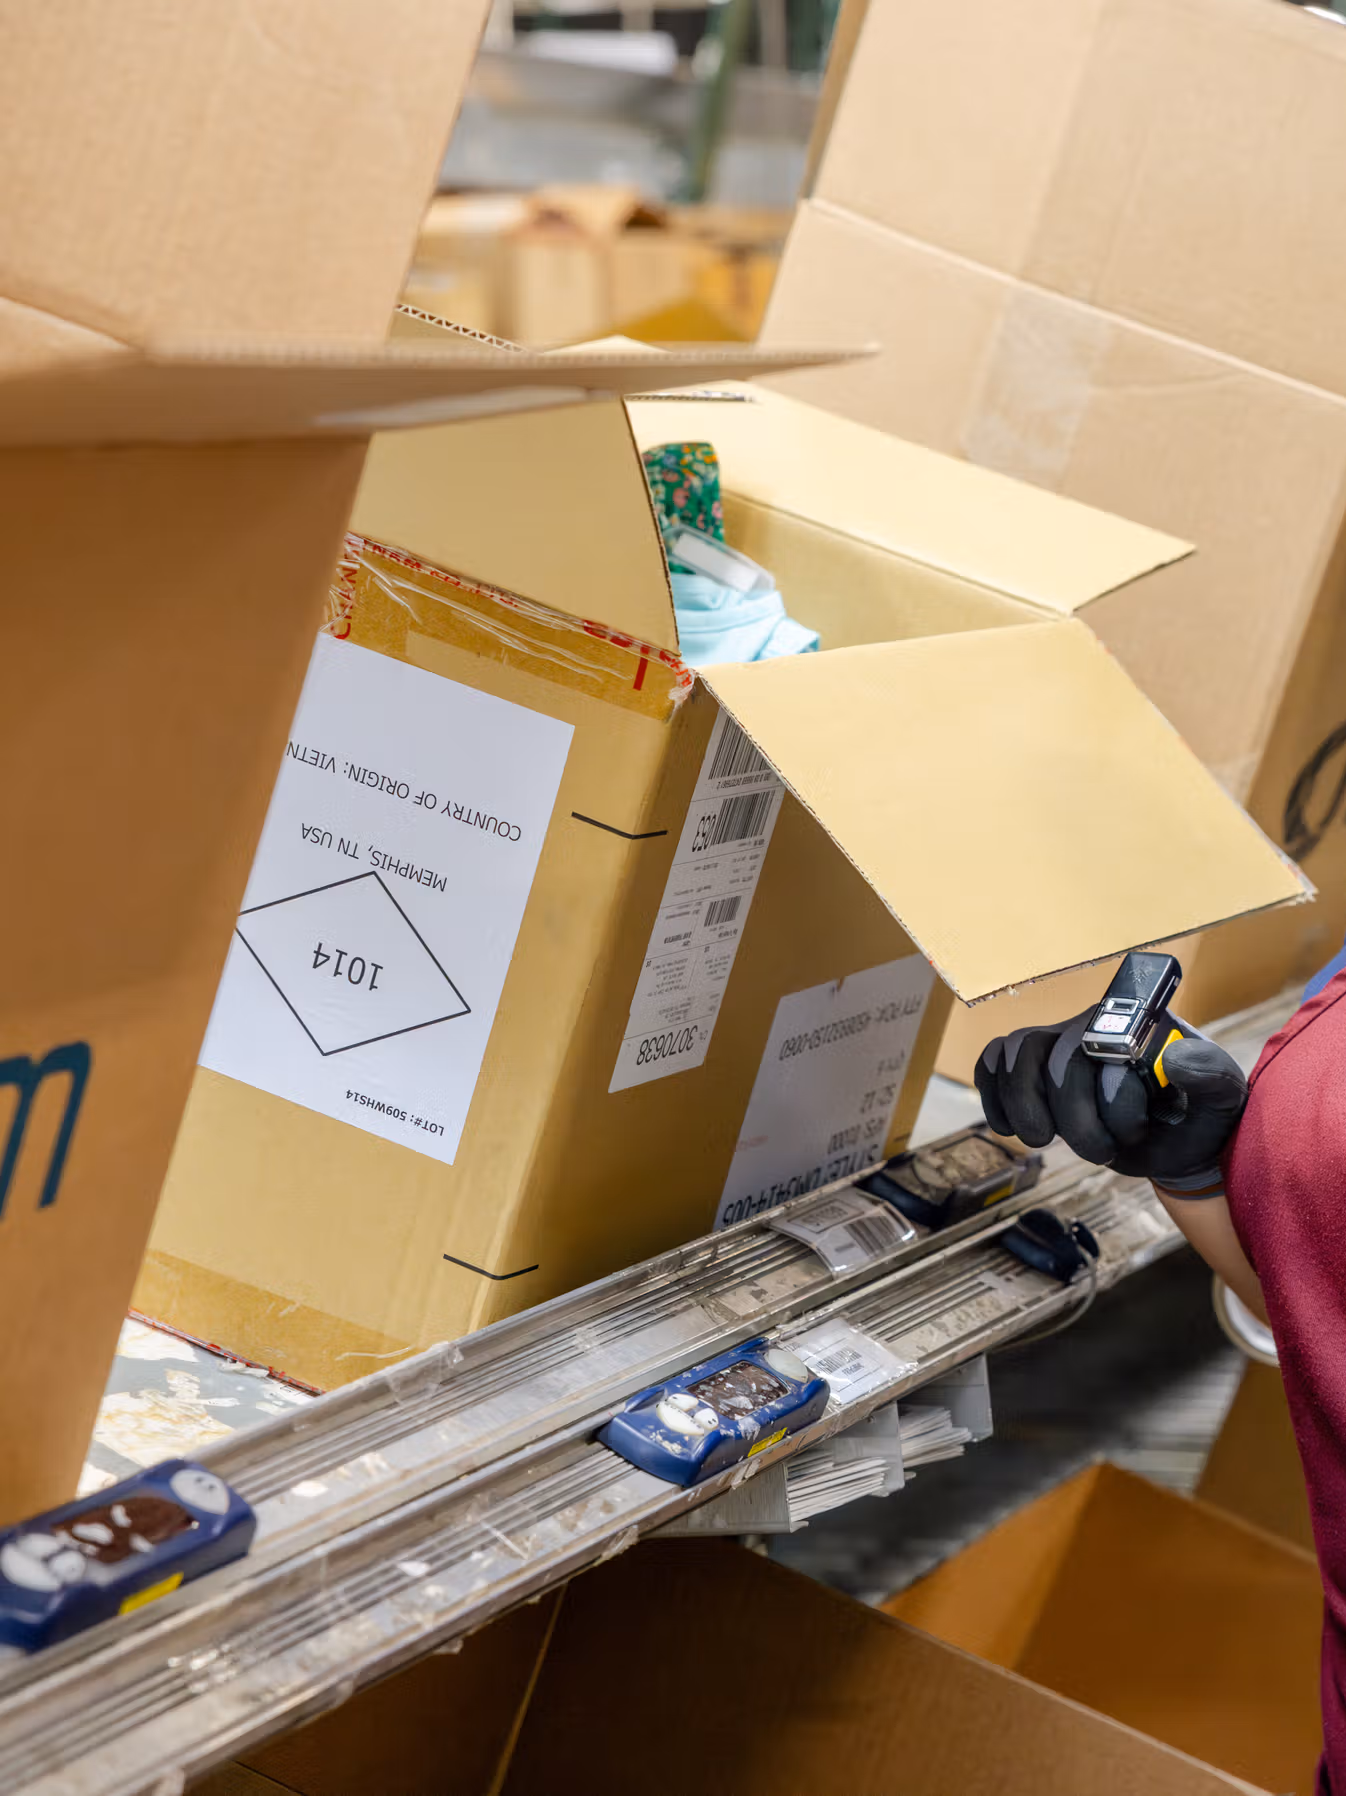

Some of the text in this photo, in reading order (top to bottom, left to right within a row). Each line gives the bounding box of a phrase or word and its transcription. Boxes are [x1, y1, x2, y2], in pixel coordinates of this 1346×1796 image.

[343, 762, 409, 799] ORIGIN:
[413, 791, 437, 810] OF
[441, 800, 521, 841] COUNTRY
[691, 814, 716, 852] 053
[301, 823, 447, 892] MEMPHIS, TN USA
[312, 942, 383, 991] 1014
[636, 1025, 698, 1065] 3070638
[346, 1089, 445, 1136] LOT#: 509WHS14
